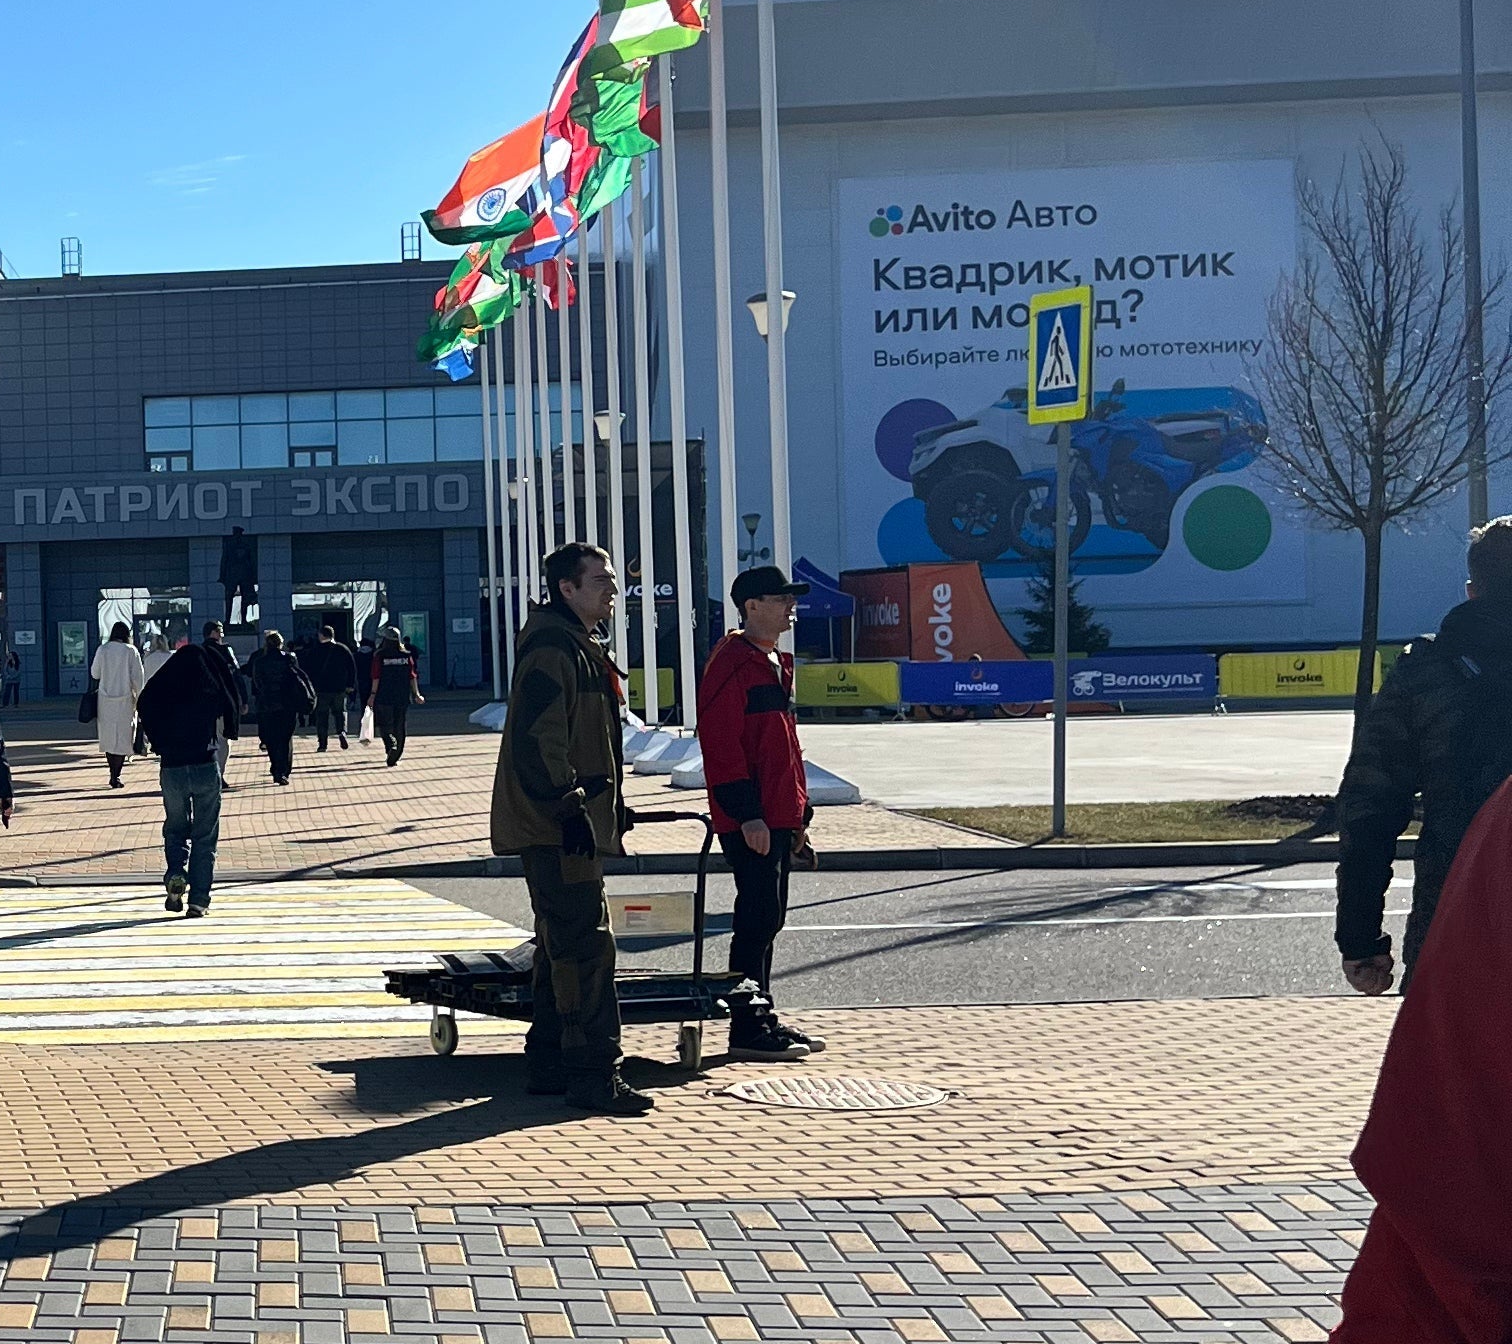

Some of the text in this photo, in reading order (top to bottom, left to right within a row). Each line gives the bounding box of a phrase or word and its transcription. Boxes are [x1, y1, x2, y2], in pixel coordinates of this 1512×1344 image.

[906, 199, 1097, 234] Avito Авто
[873, 252, 1235, 296] Квадрик, мотик
[874, 289, 1144, 333] или мод?
[874, 345, 999, 368] Выбирайте
[1120, 339, 1263, 357] мототехнику
[13, 473, 469, 525] ПАТРИОТ ЭКСПО
[928, 582, 954, 662] voke
[955, 681, 999, 693] invoke
[1102, 673, 1203, 687] Велокульт
[1277, 672, 1323, 684] invoke
